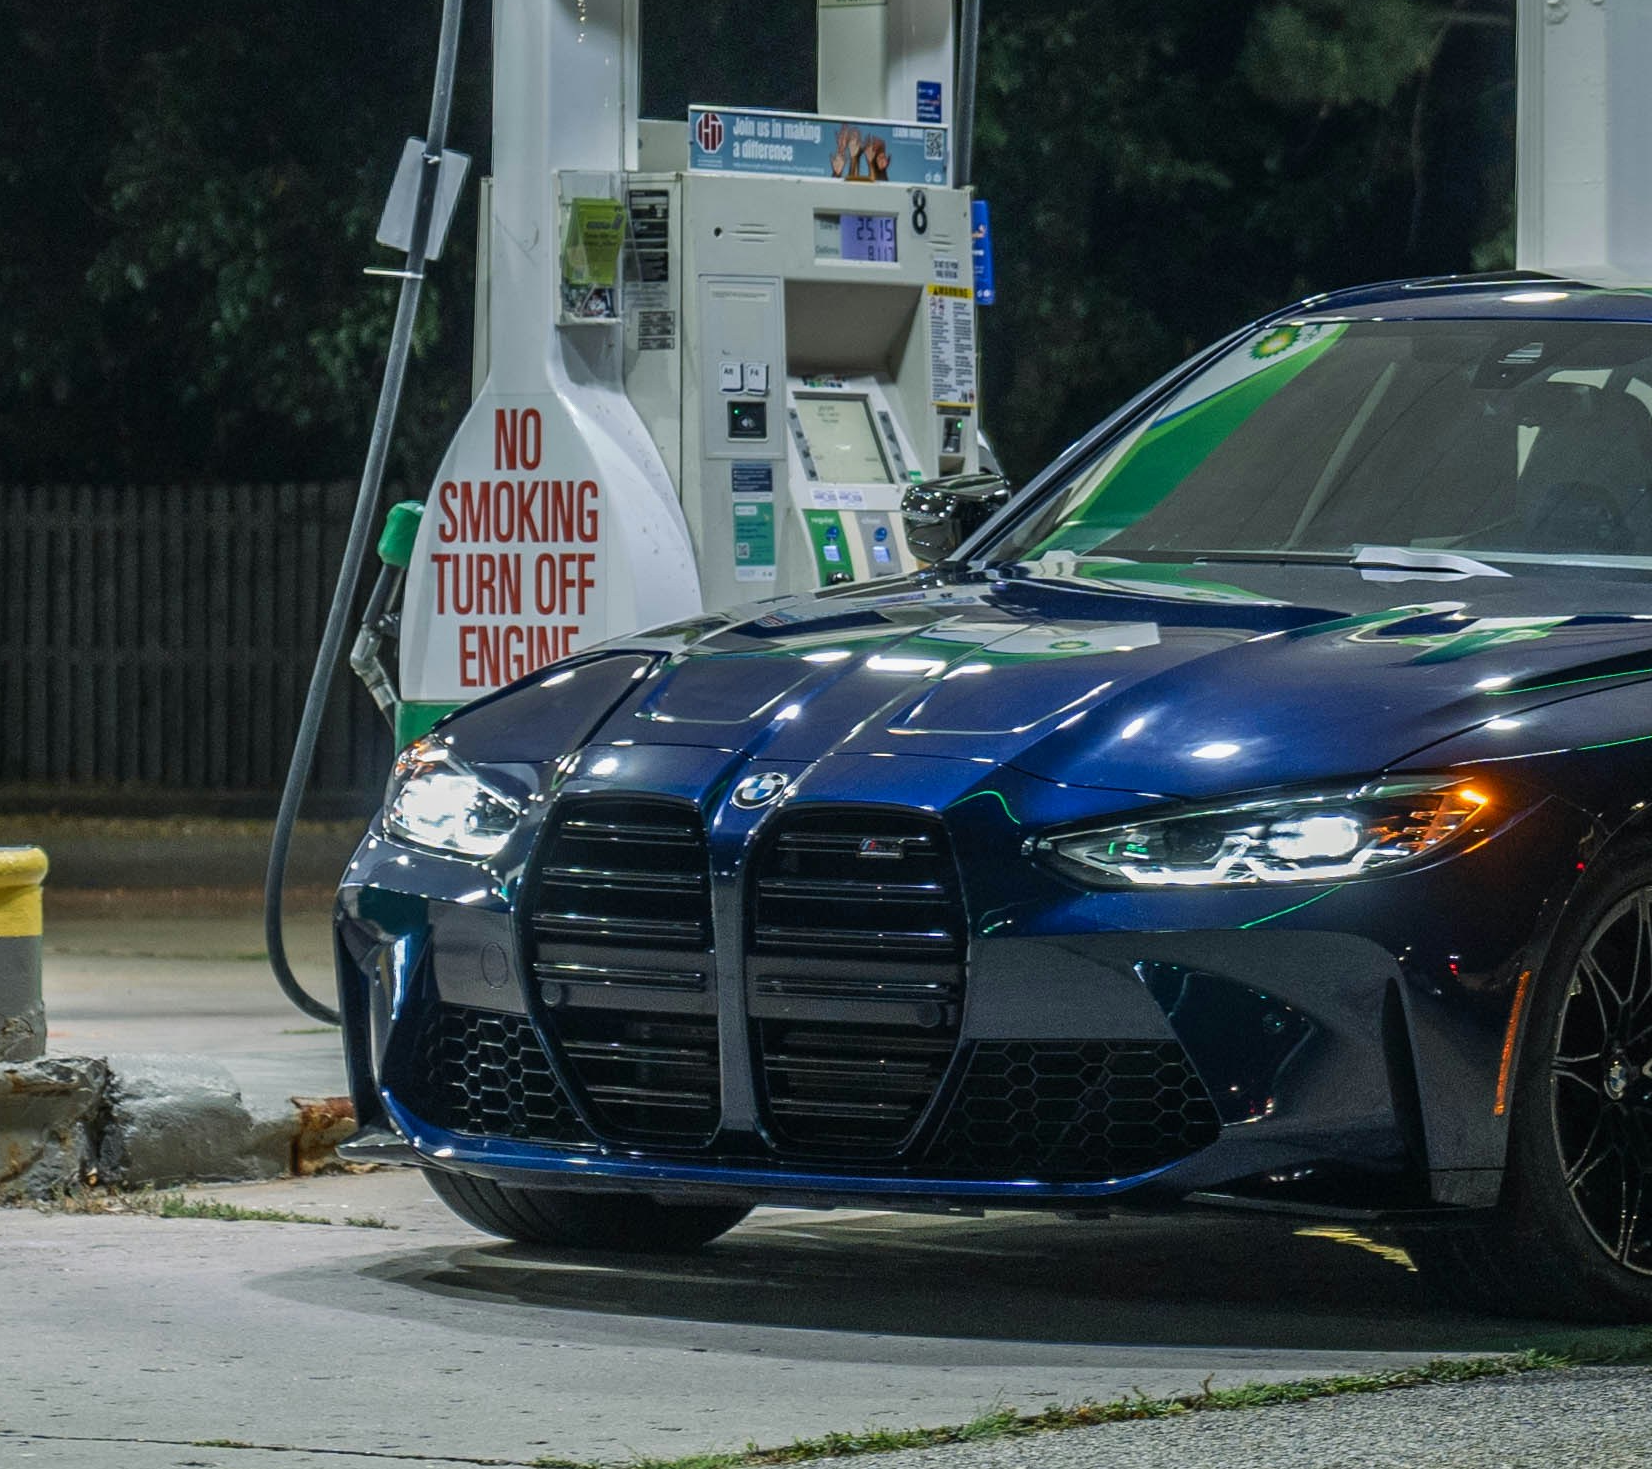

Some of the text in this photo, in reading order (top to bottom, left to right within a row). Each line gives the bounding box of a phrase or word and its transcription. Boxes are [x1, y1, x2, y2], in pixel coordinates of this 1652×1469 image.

[732, 116, 822, 144] Join us in making
[732, 140, 794, 162] a difference
[912, 190, 928, 234] 8
[495, 407, 542, 471] NO
[438, 480, 599, 544] SMOKING
[431, 553, 596, 616] TURN OFF
